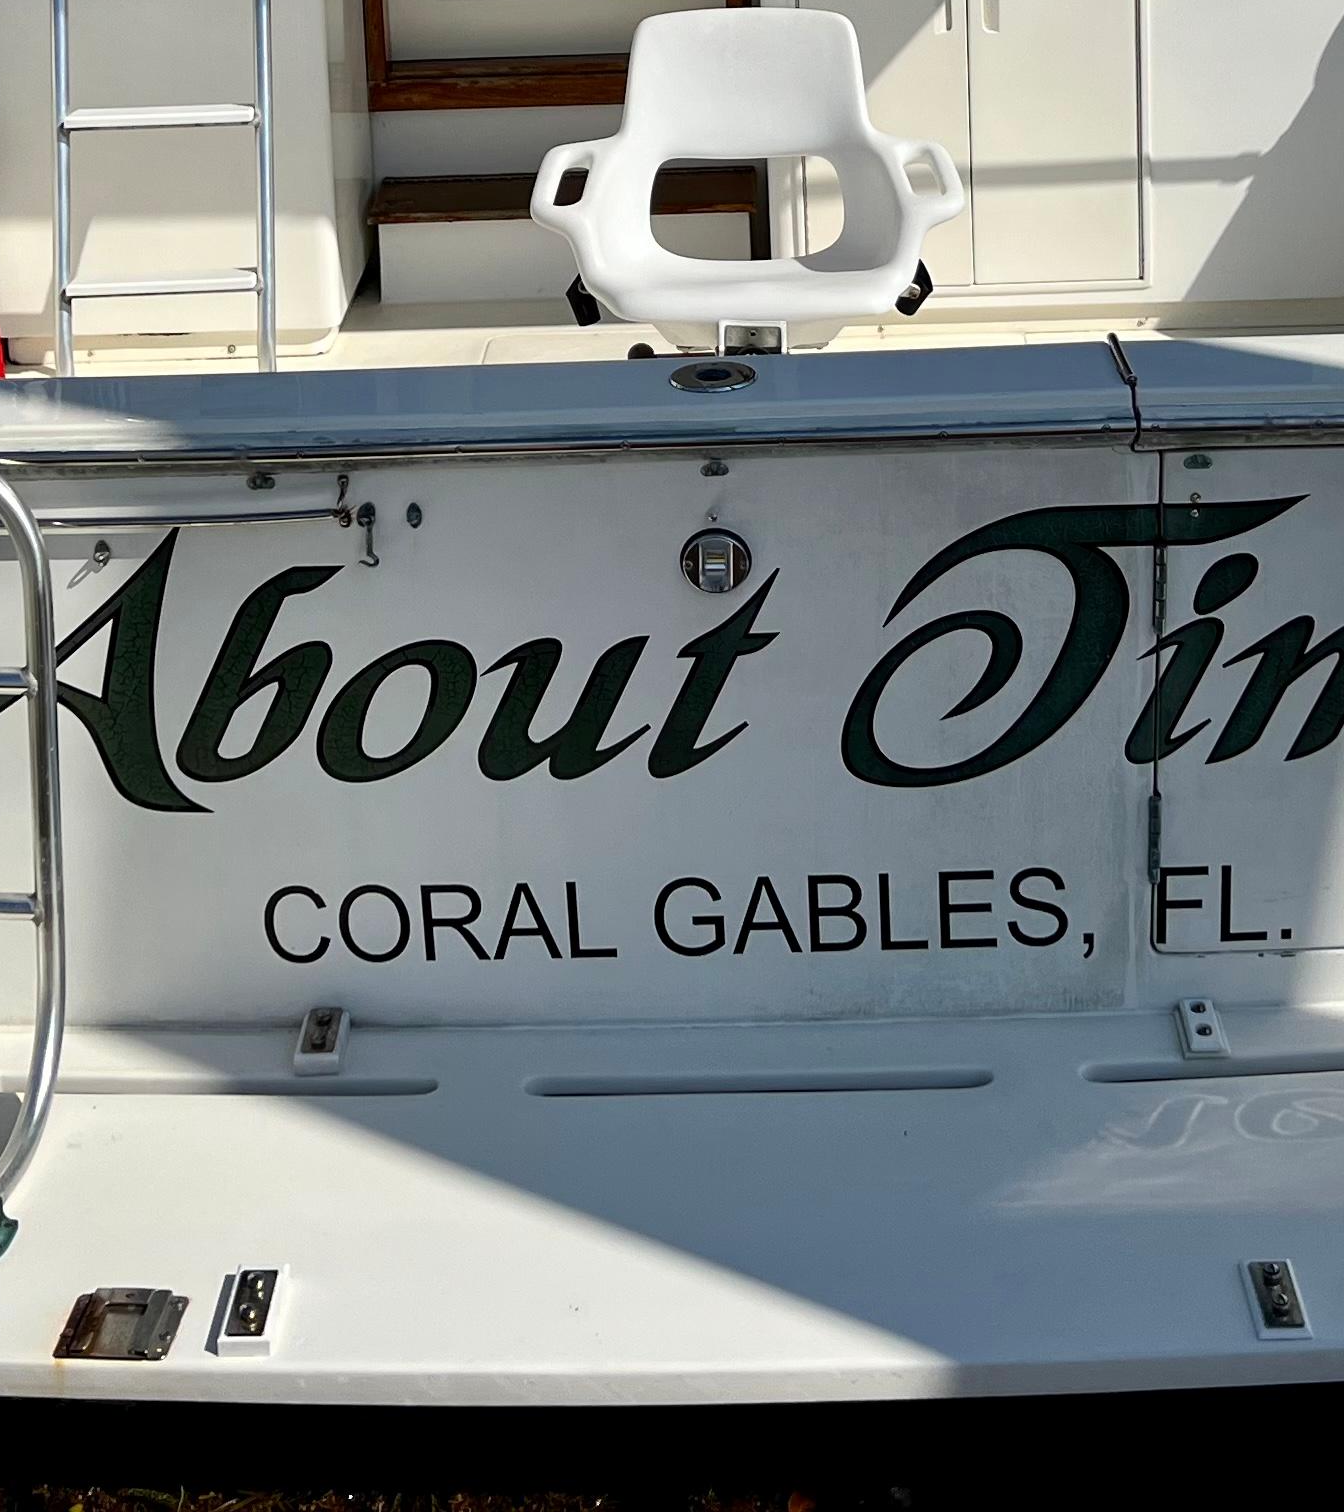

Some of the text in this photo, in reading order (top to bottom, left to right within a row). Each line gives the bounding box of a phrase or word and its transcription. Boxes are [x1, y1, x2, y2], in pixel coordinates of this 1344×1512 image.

[264, 864, 1293, 964] CORAL GABLES, FL.
